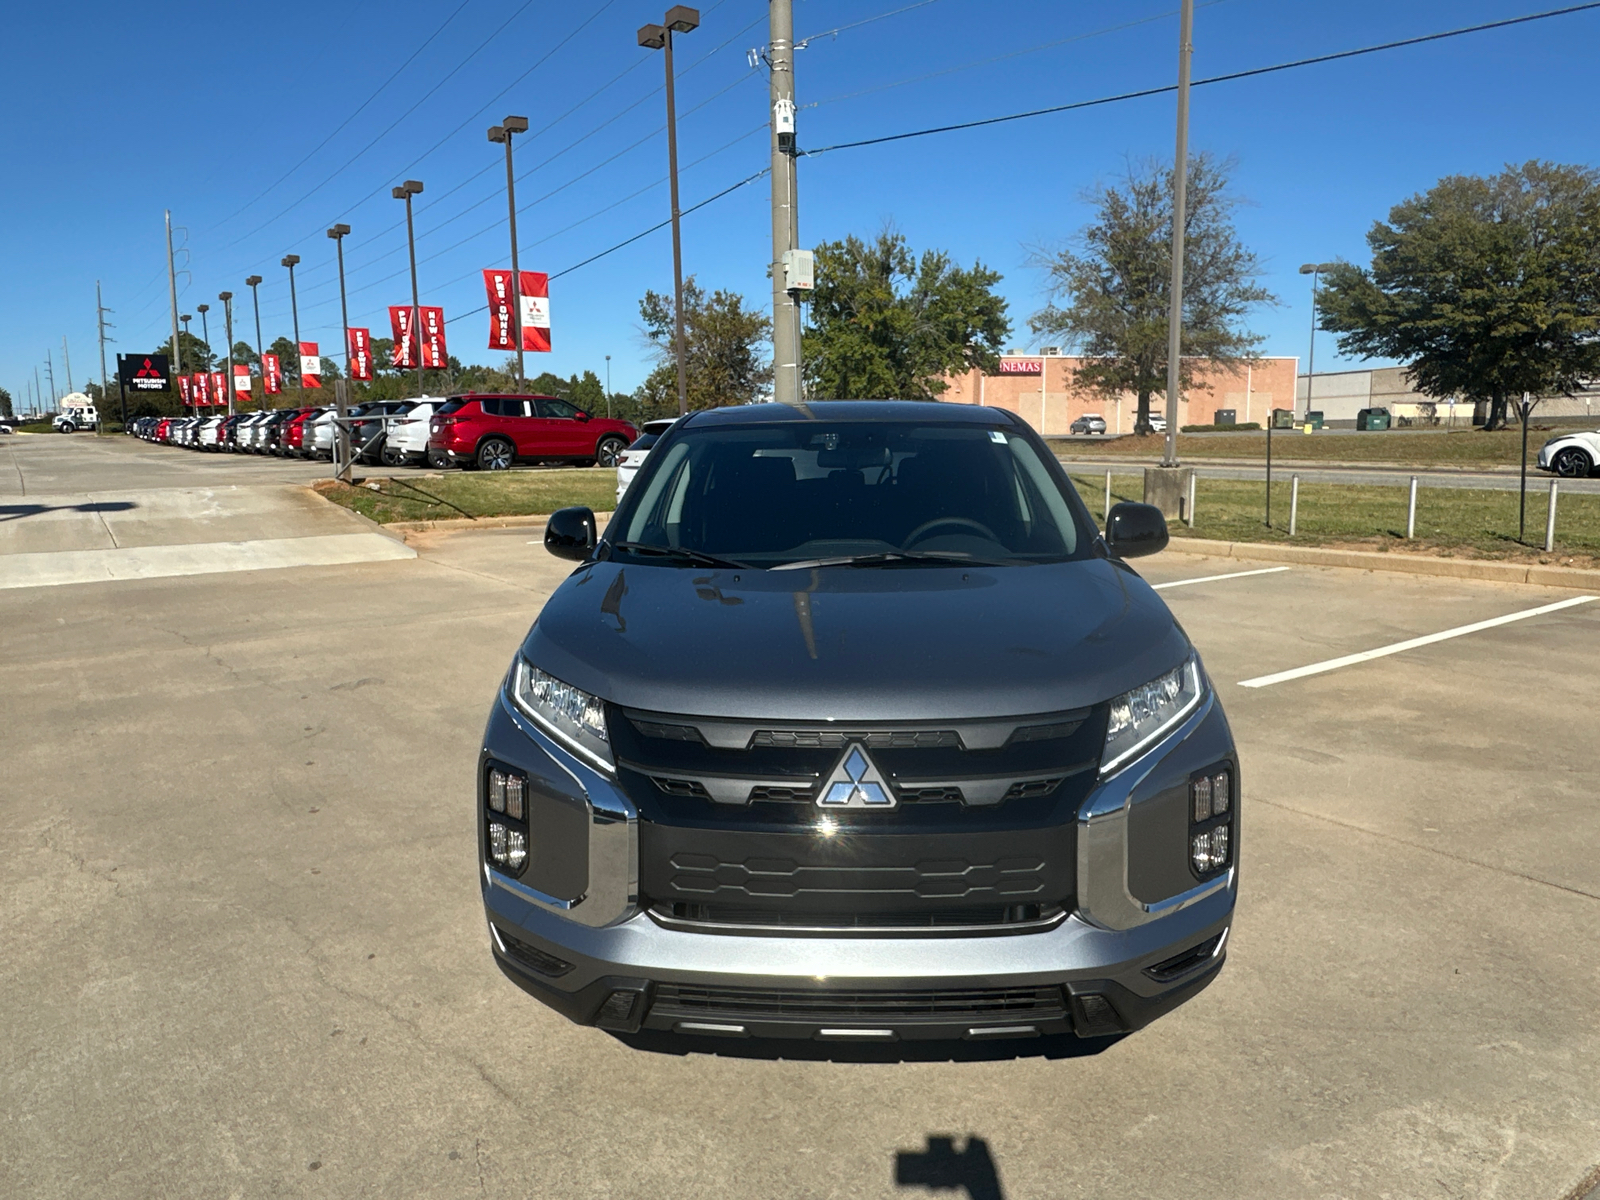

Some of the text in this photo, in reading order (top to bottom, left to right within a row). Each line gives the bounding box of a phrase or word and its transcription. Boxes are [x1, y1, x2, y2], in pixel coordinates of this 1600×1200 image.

[428, 311, 439, 367] NEW CARS
[494, 275, 508, 345] PRE-OWNED
